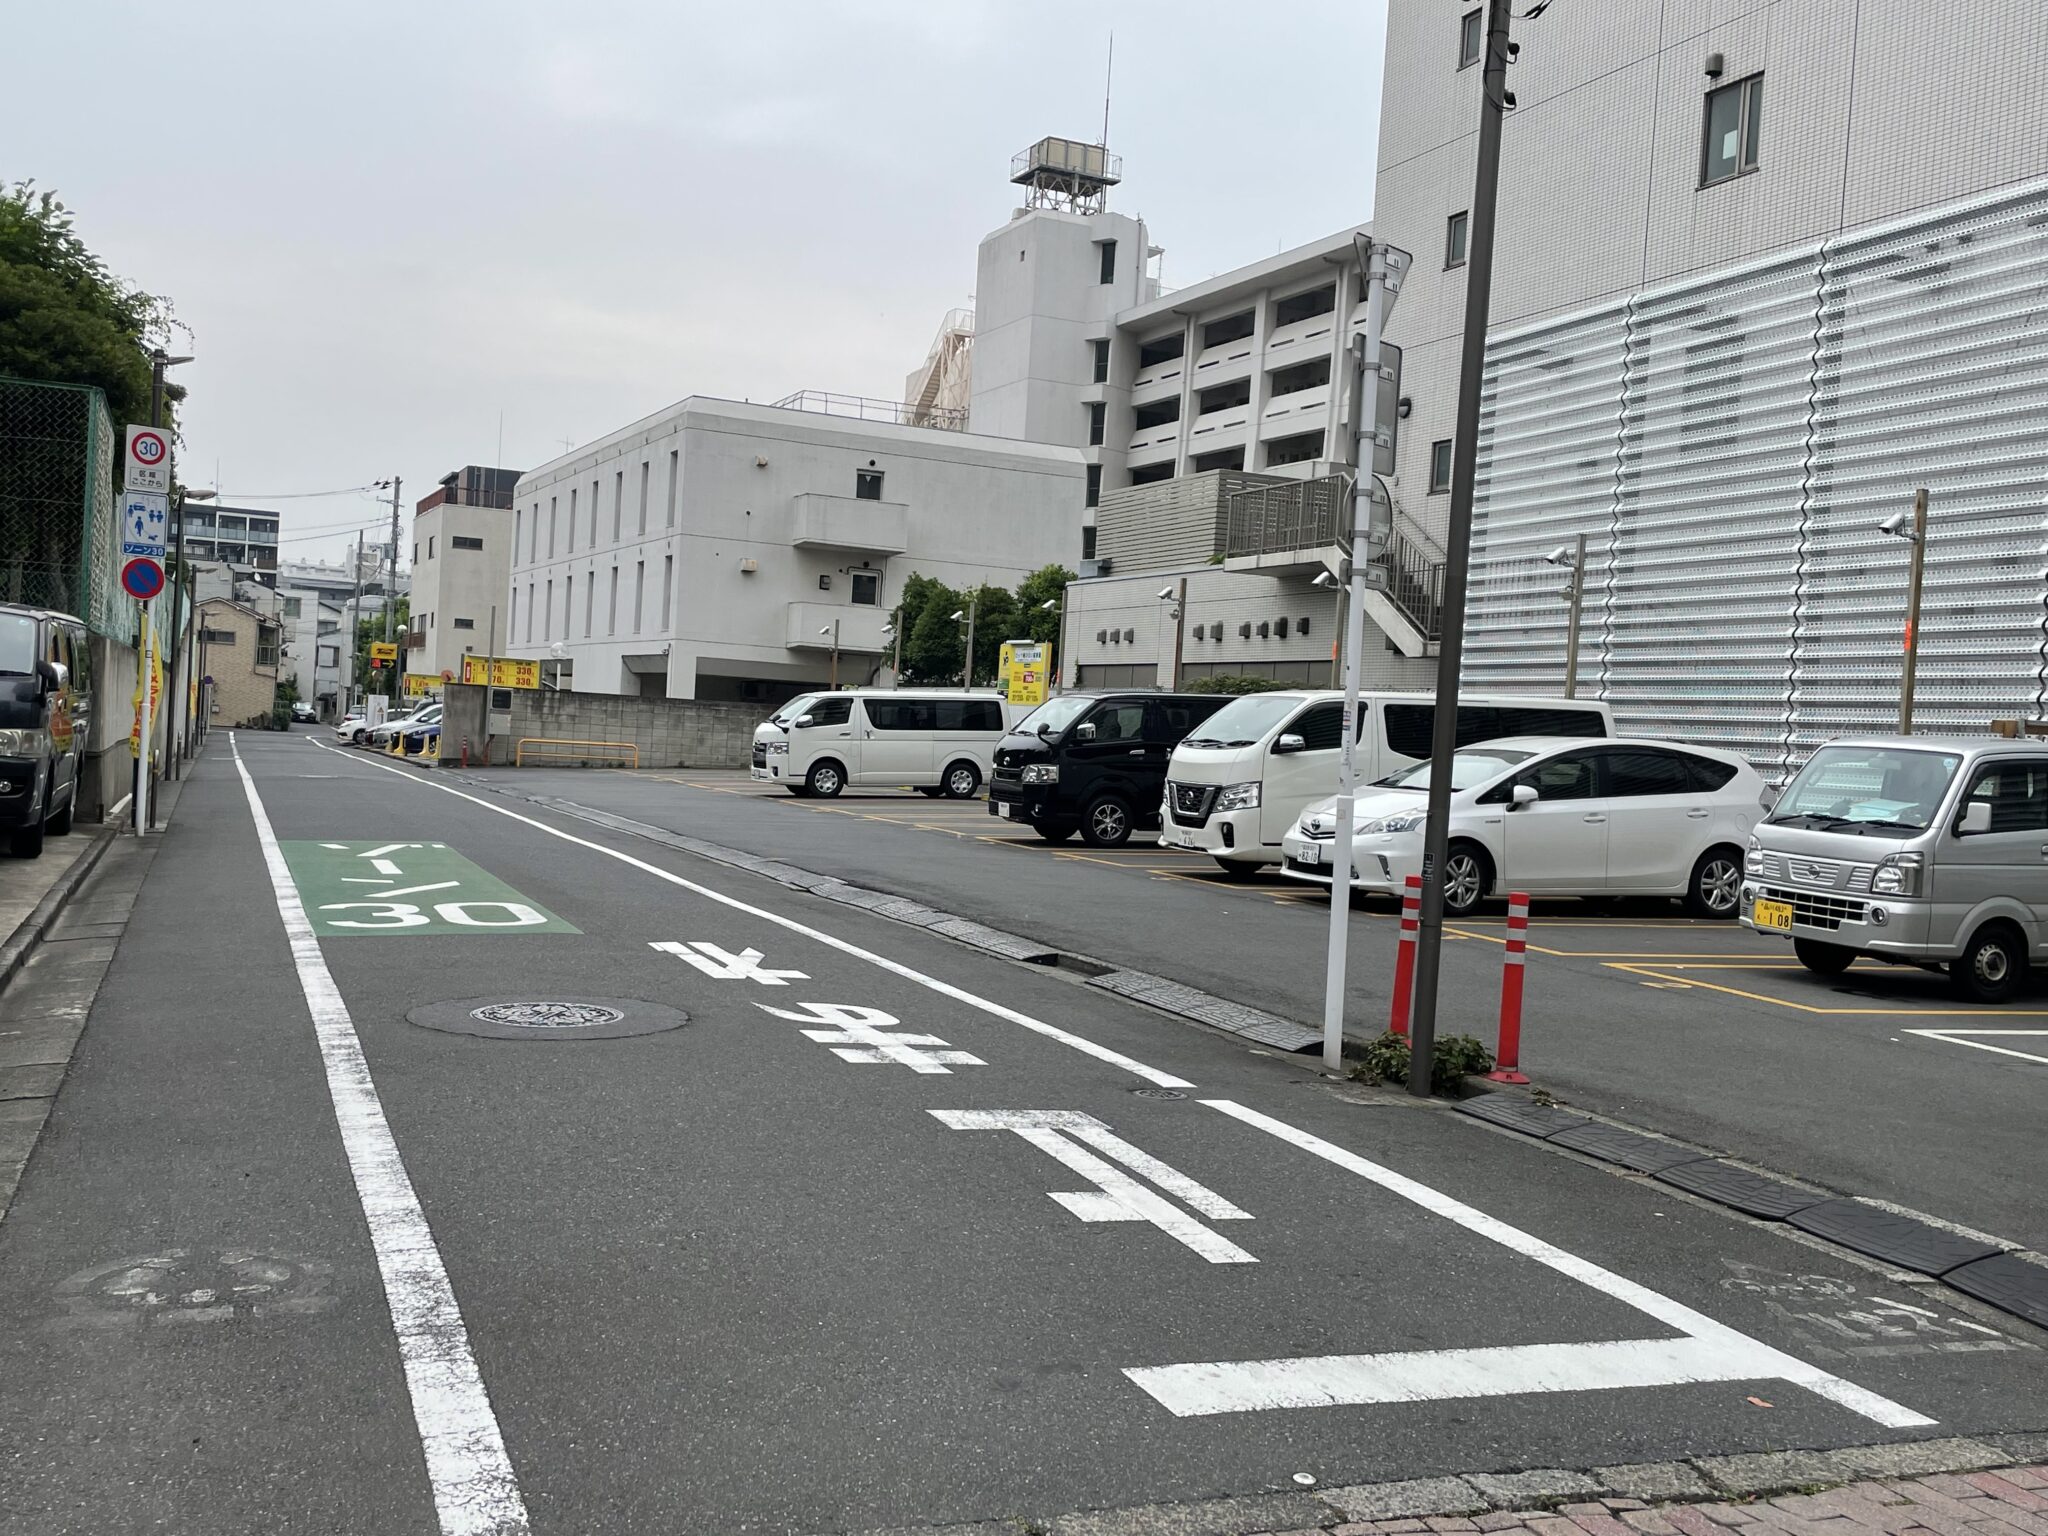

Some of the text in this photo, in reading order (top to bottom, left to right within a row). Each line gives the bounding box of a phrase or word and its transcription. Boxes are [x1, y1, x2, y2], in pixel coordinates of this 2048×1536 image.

[138, 440, 159, 457] 30
[131, 476, 163, 488] ここから
[125, 544, 164, 556] ゾーン30
[648, 941, 1259, 1265] 止まれ
